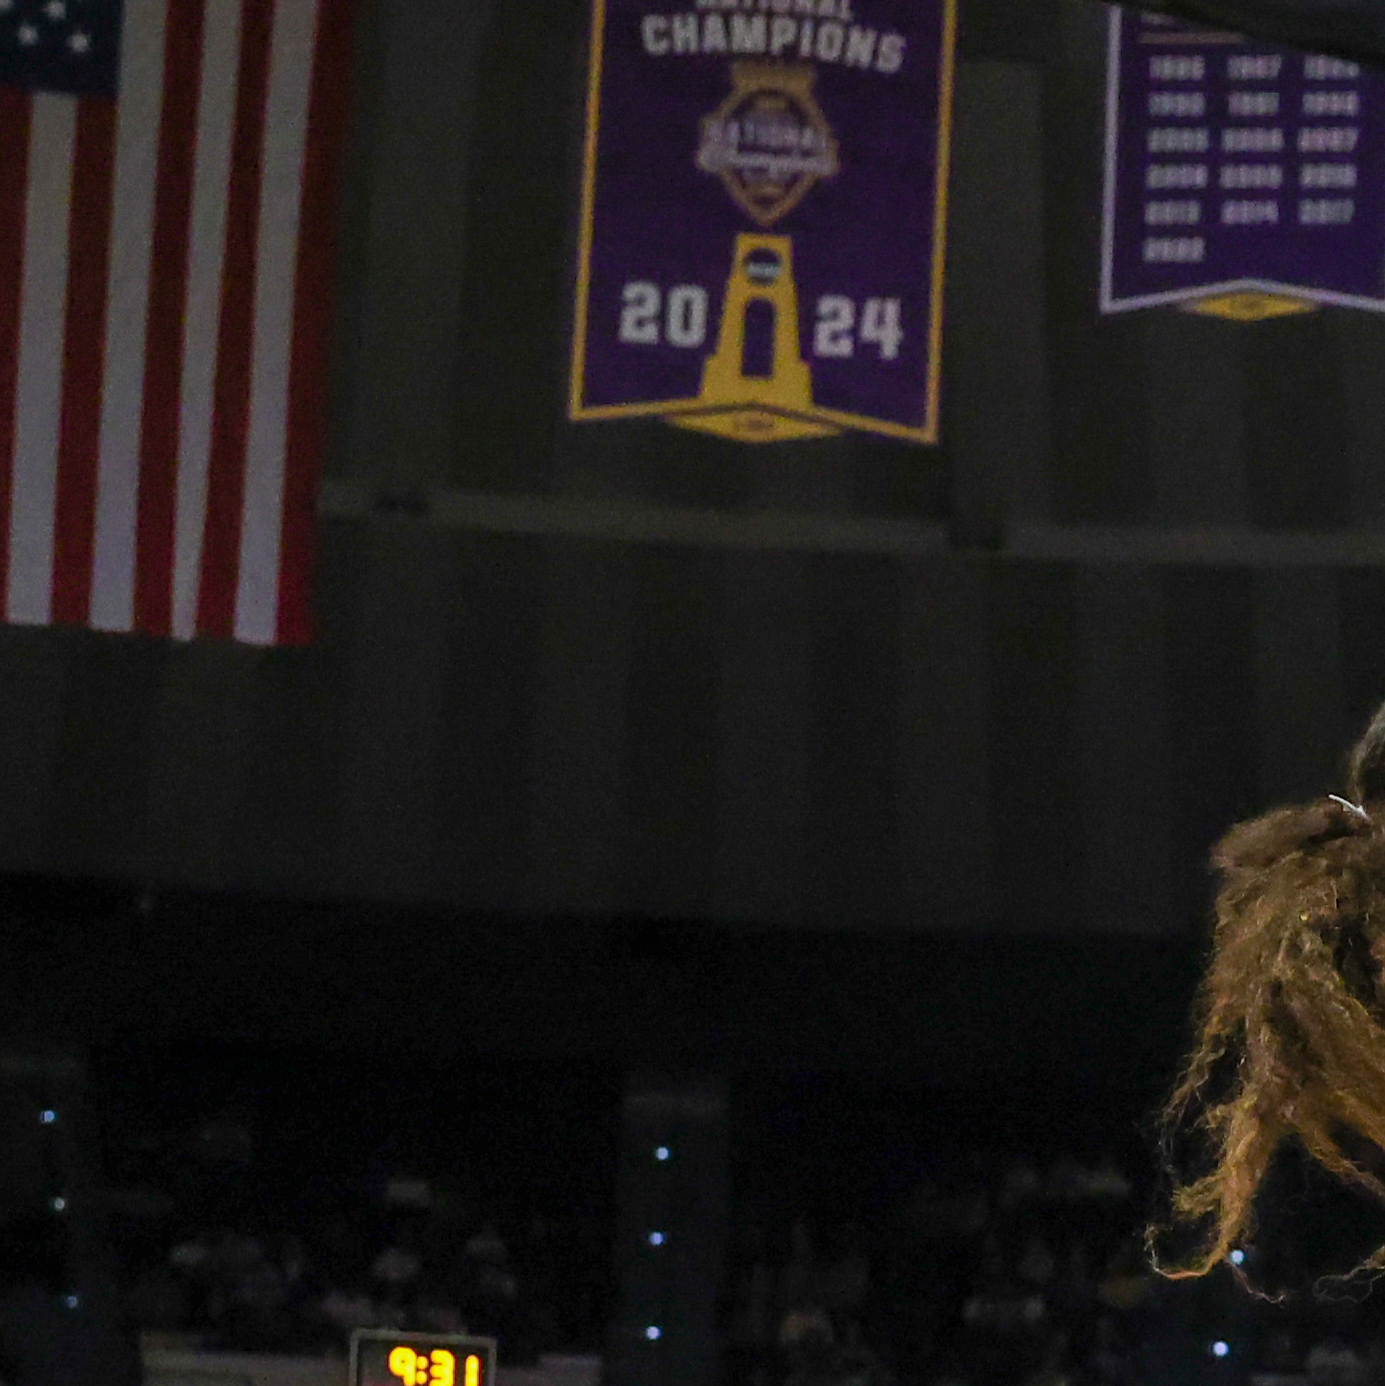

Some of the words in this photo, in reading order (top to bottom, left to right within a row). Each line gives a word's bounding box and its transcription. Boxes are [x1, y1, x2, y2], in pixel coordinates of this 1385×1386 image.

[641, 14, 905, 73] CHAMPIONS
[618, 281, 709, 348] 20
[813, 295, 904, 361] 24
